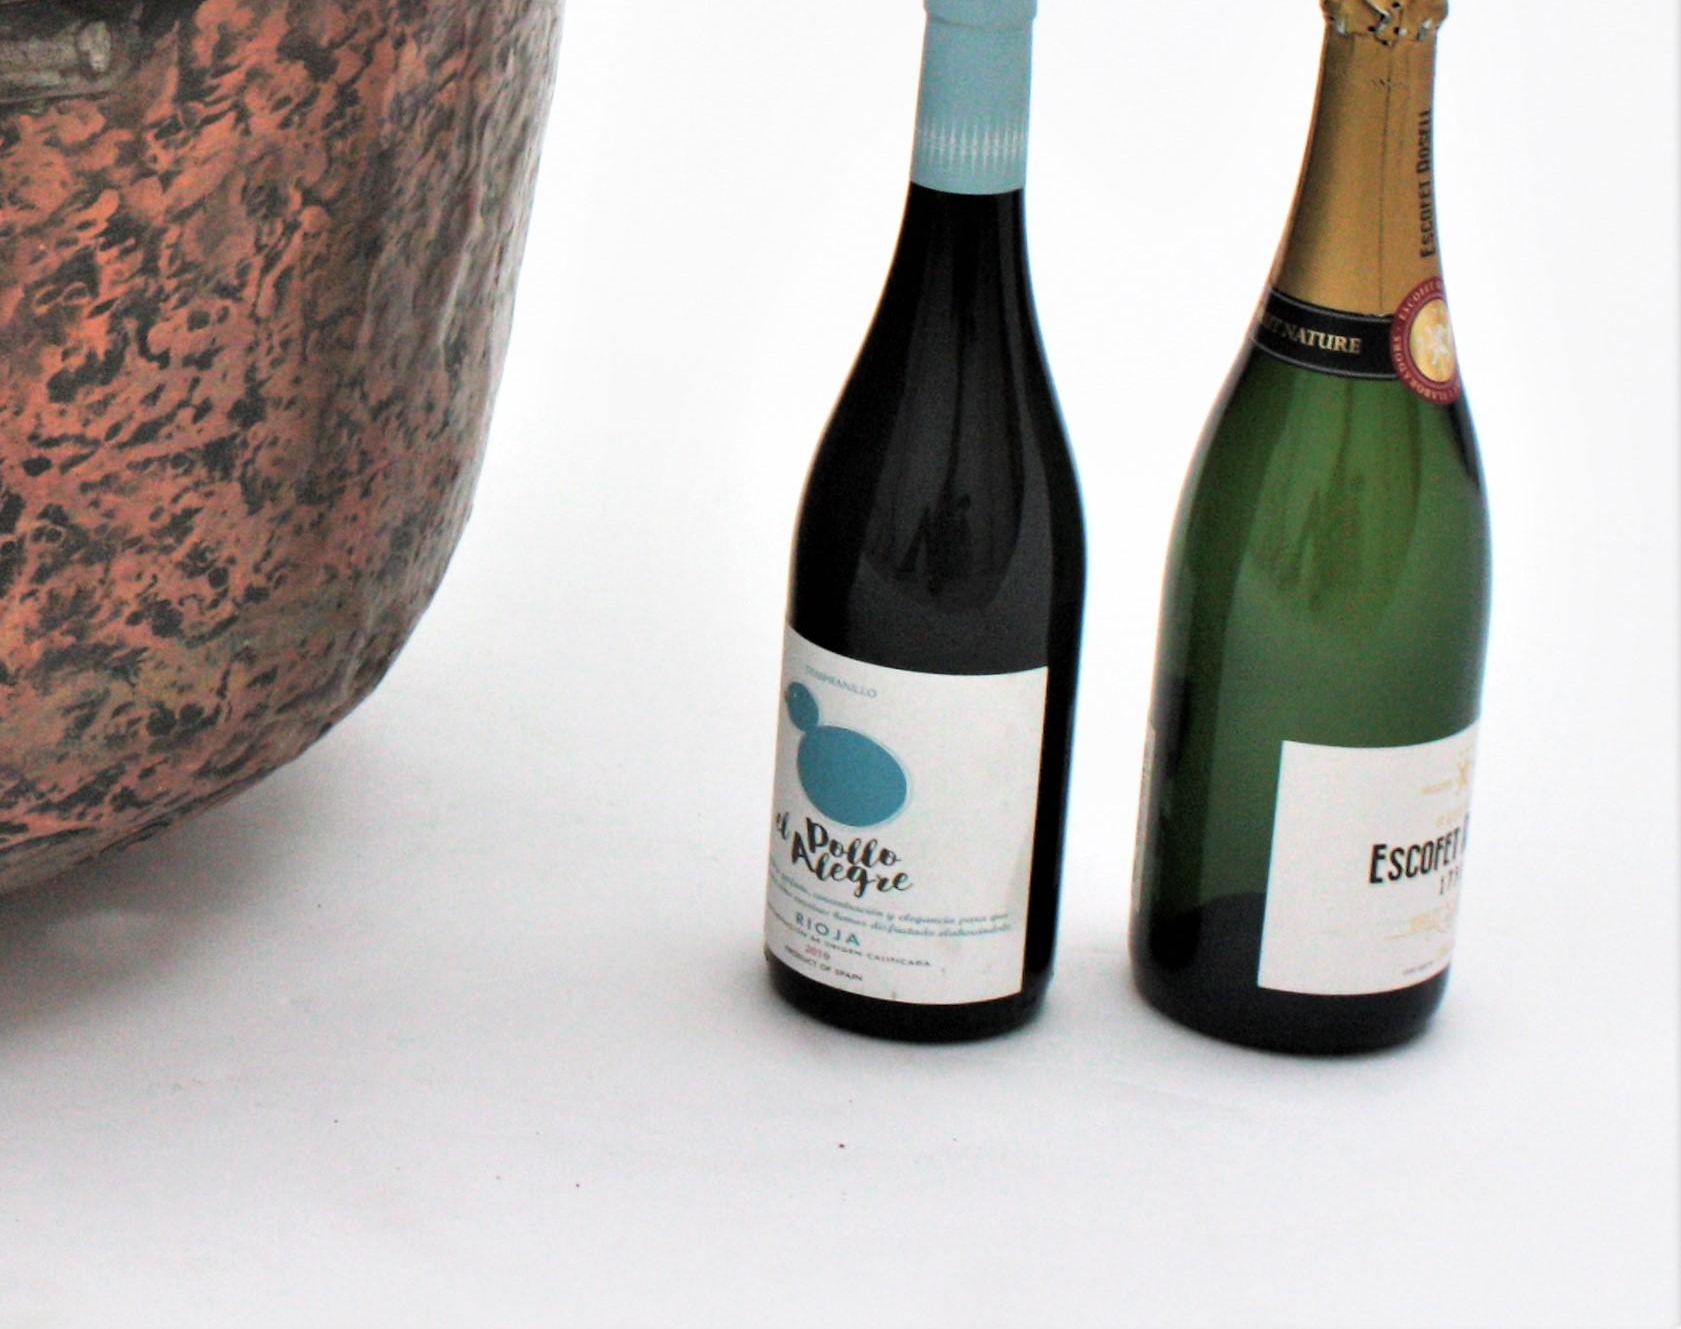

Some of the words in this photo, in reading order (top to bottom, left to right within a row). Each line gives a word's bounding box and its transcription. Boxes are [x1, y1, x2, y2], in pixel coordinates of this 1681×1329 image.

[1283, 323, 1362, 354] NATURE
[790, 830, 913, 898] Alegre
[805, 816, 902, 868] Pollo
[1369, 826, 1460, 884] ESCOFET
[795, 911, 861, 947] RIOJA
[834, 968, 863, 982] SPAIN
